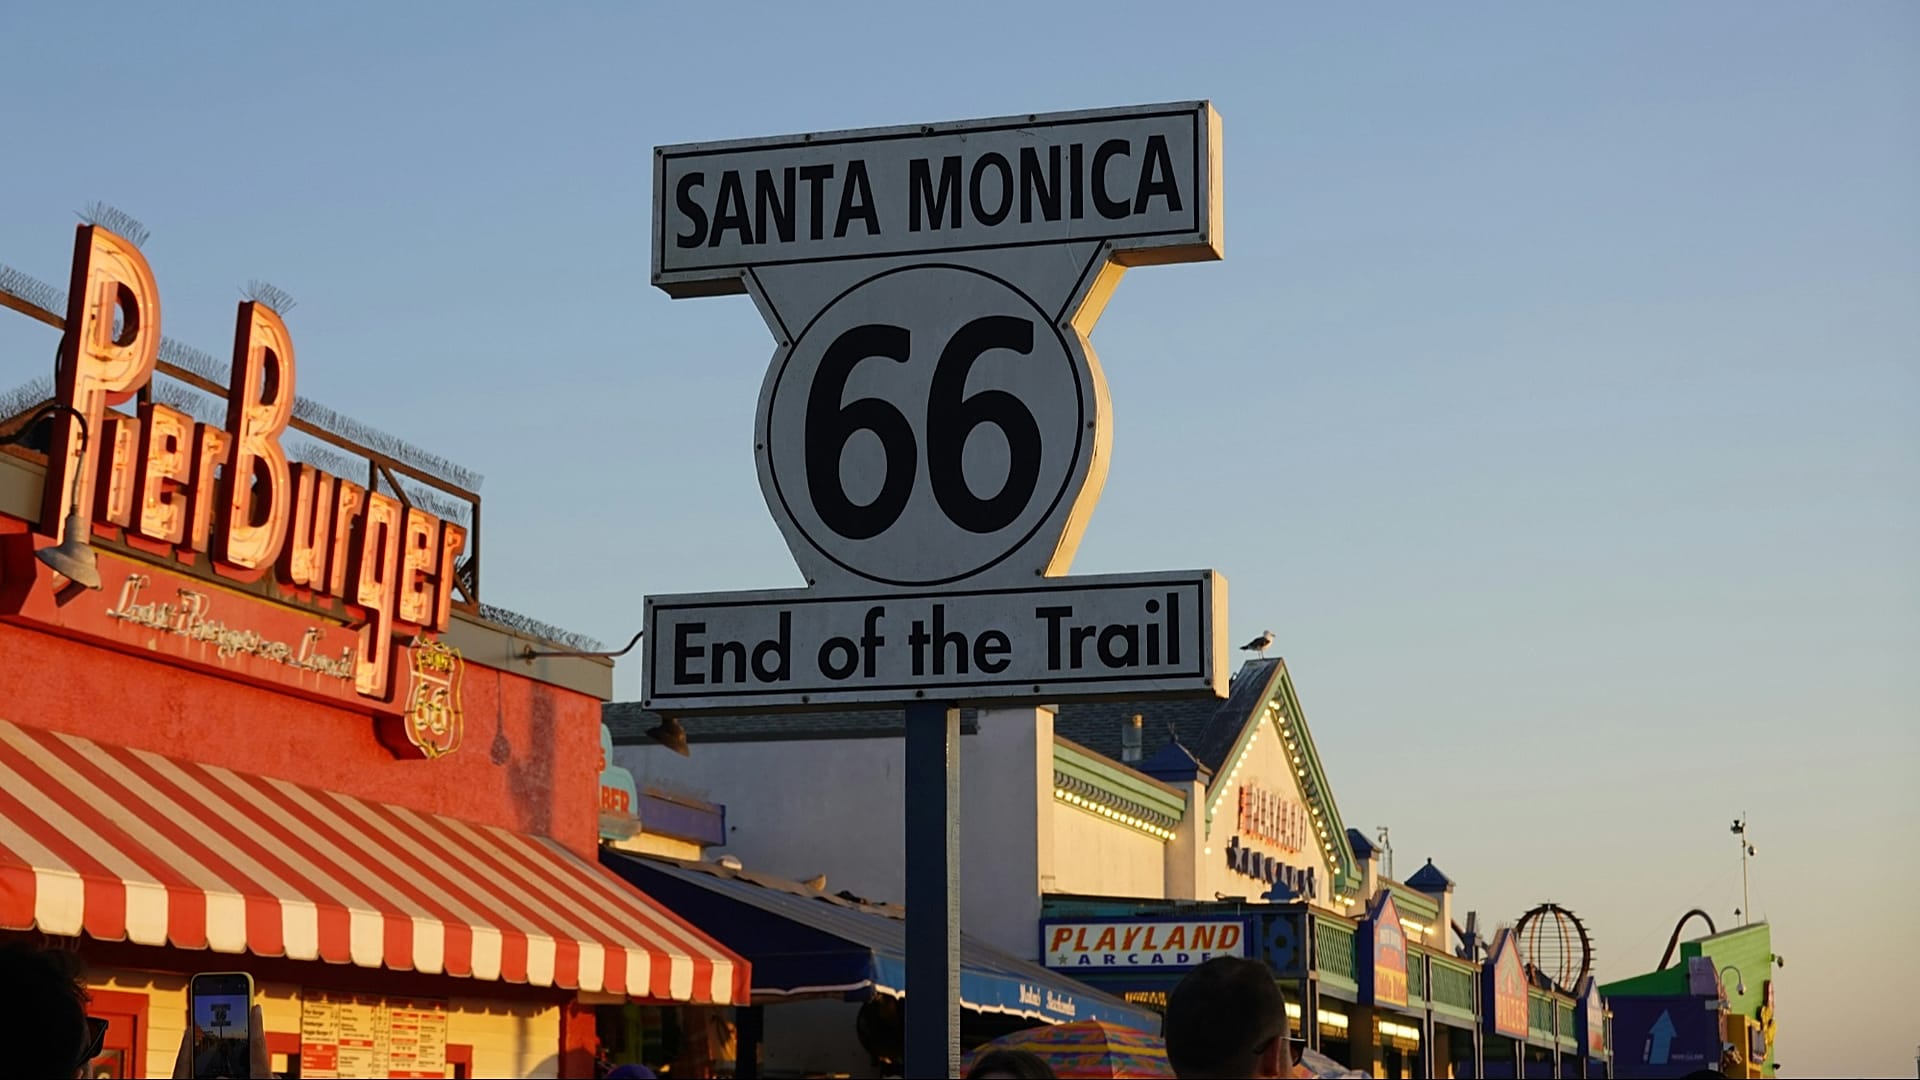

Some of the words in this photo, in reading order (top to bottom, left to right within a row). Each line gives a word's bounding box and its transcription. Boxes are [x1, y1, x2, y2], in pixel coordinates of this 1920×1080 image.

[676, 160, 881, 248] SANTA
[909, 135, 1183, 232] MONICA
[805, 316, 1042, 540] 66
[674, 611, 791, 685] End
[818, 606, 885, 680] of
[908, 604, 1011, 676] the
[1036, 592, 1179, 670] Trail
[411, 682, 448, 735] 66
[1051, 925, 1240, 952] PLAYLAND
